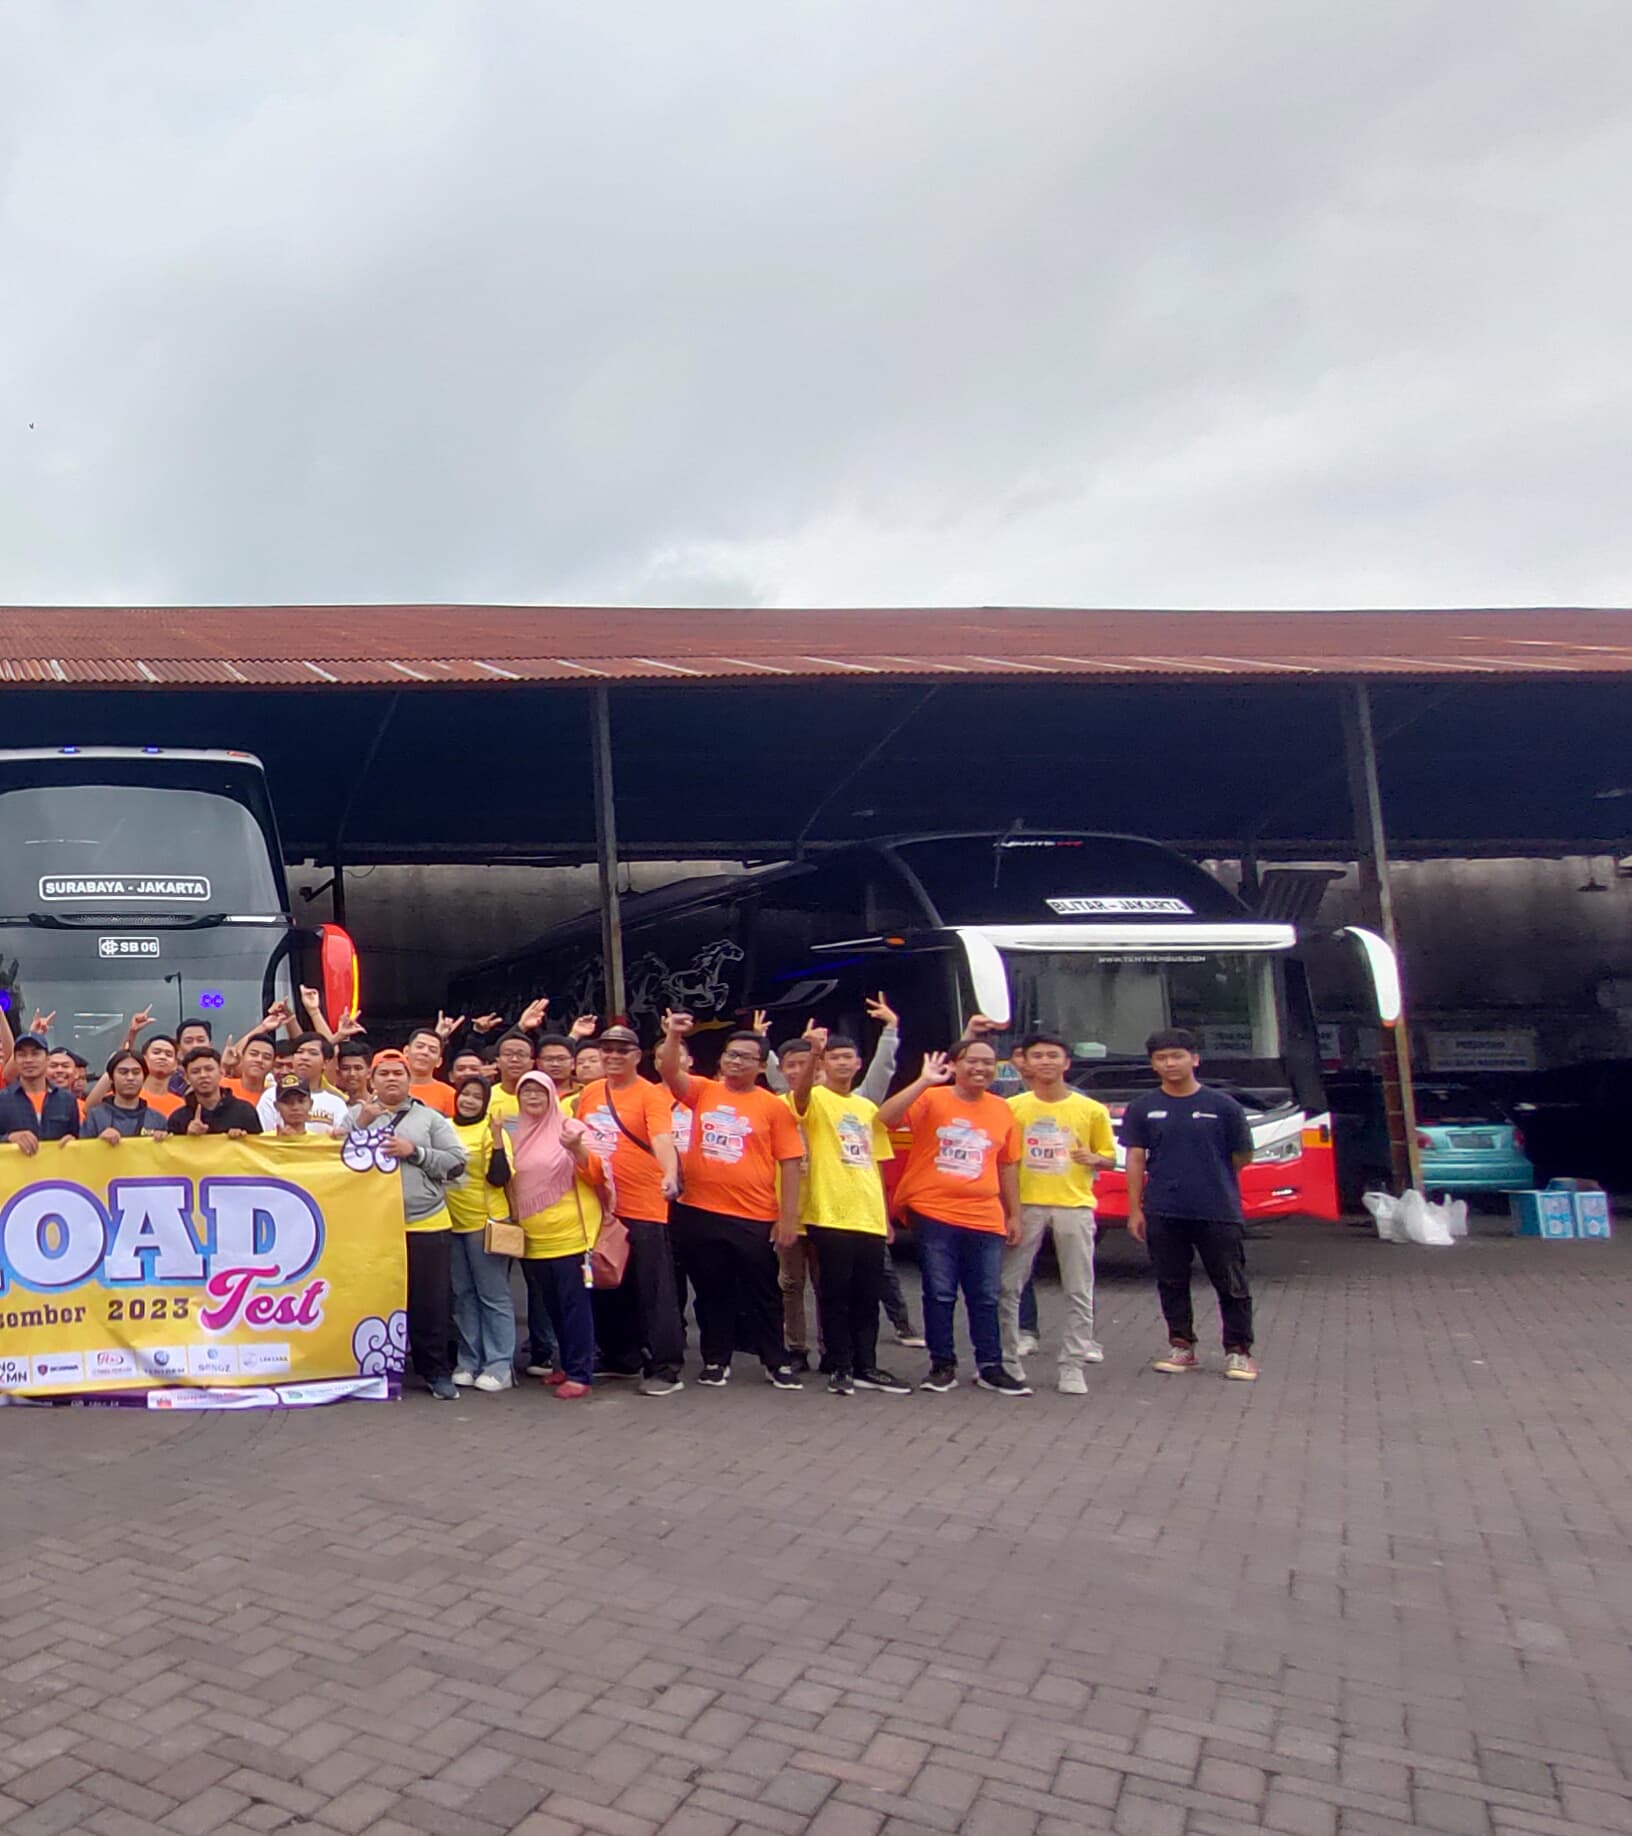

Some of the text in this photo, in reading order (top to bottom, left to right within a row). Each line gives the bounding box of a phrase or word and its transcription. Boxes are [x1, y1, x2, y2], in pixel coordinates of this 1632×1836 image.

[45, 881, 125, 894] SURABAYA
[136, 881, 205, 895] JAKARTA
[1050, 900, 1106, 912] BLITAR
[1118, 900, 1186, 912] JAKARTA
[120, 942, 158, 953] SB 06
[199, 1264, 326, 1330] Test
[106, 1297, 191, 1322] 2023
